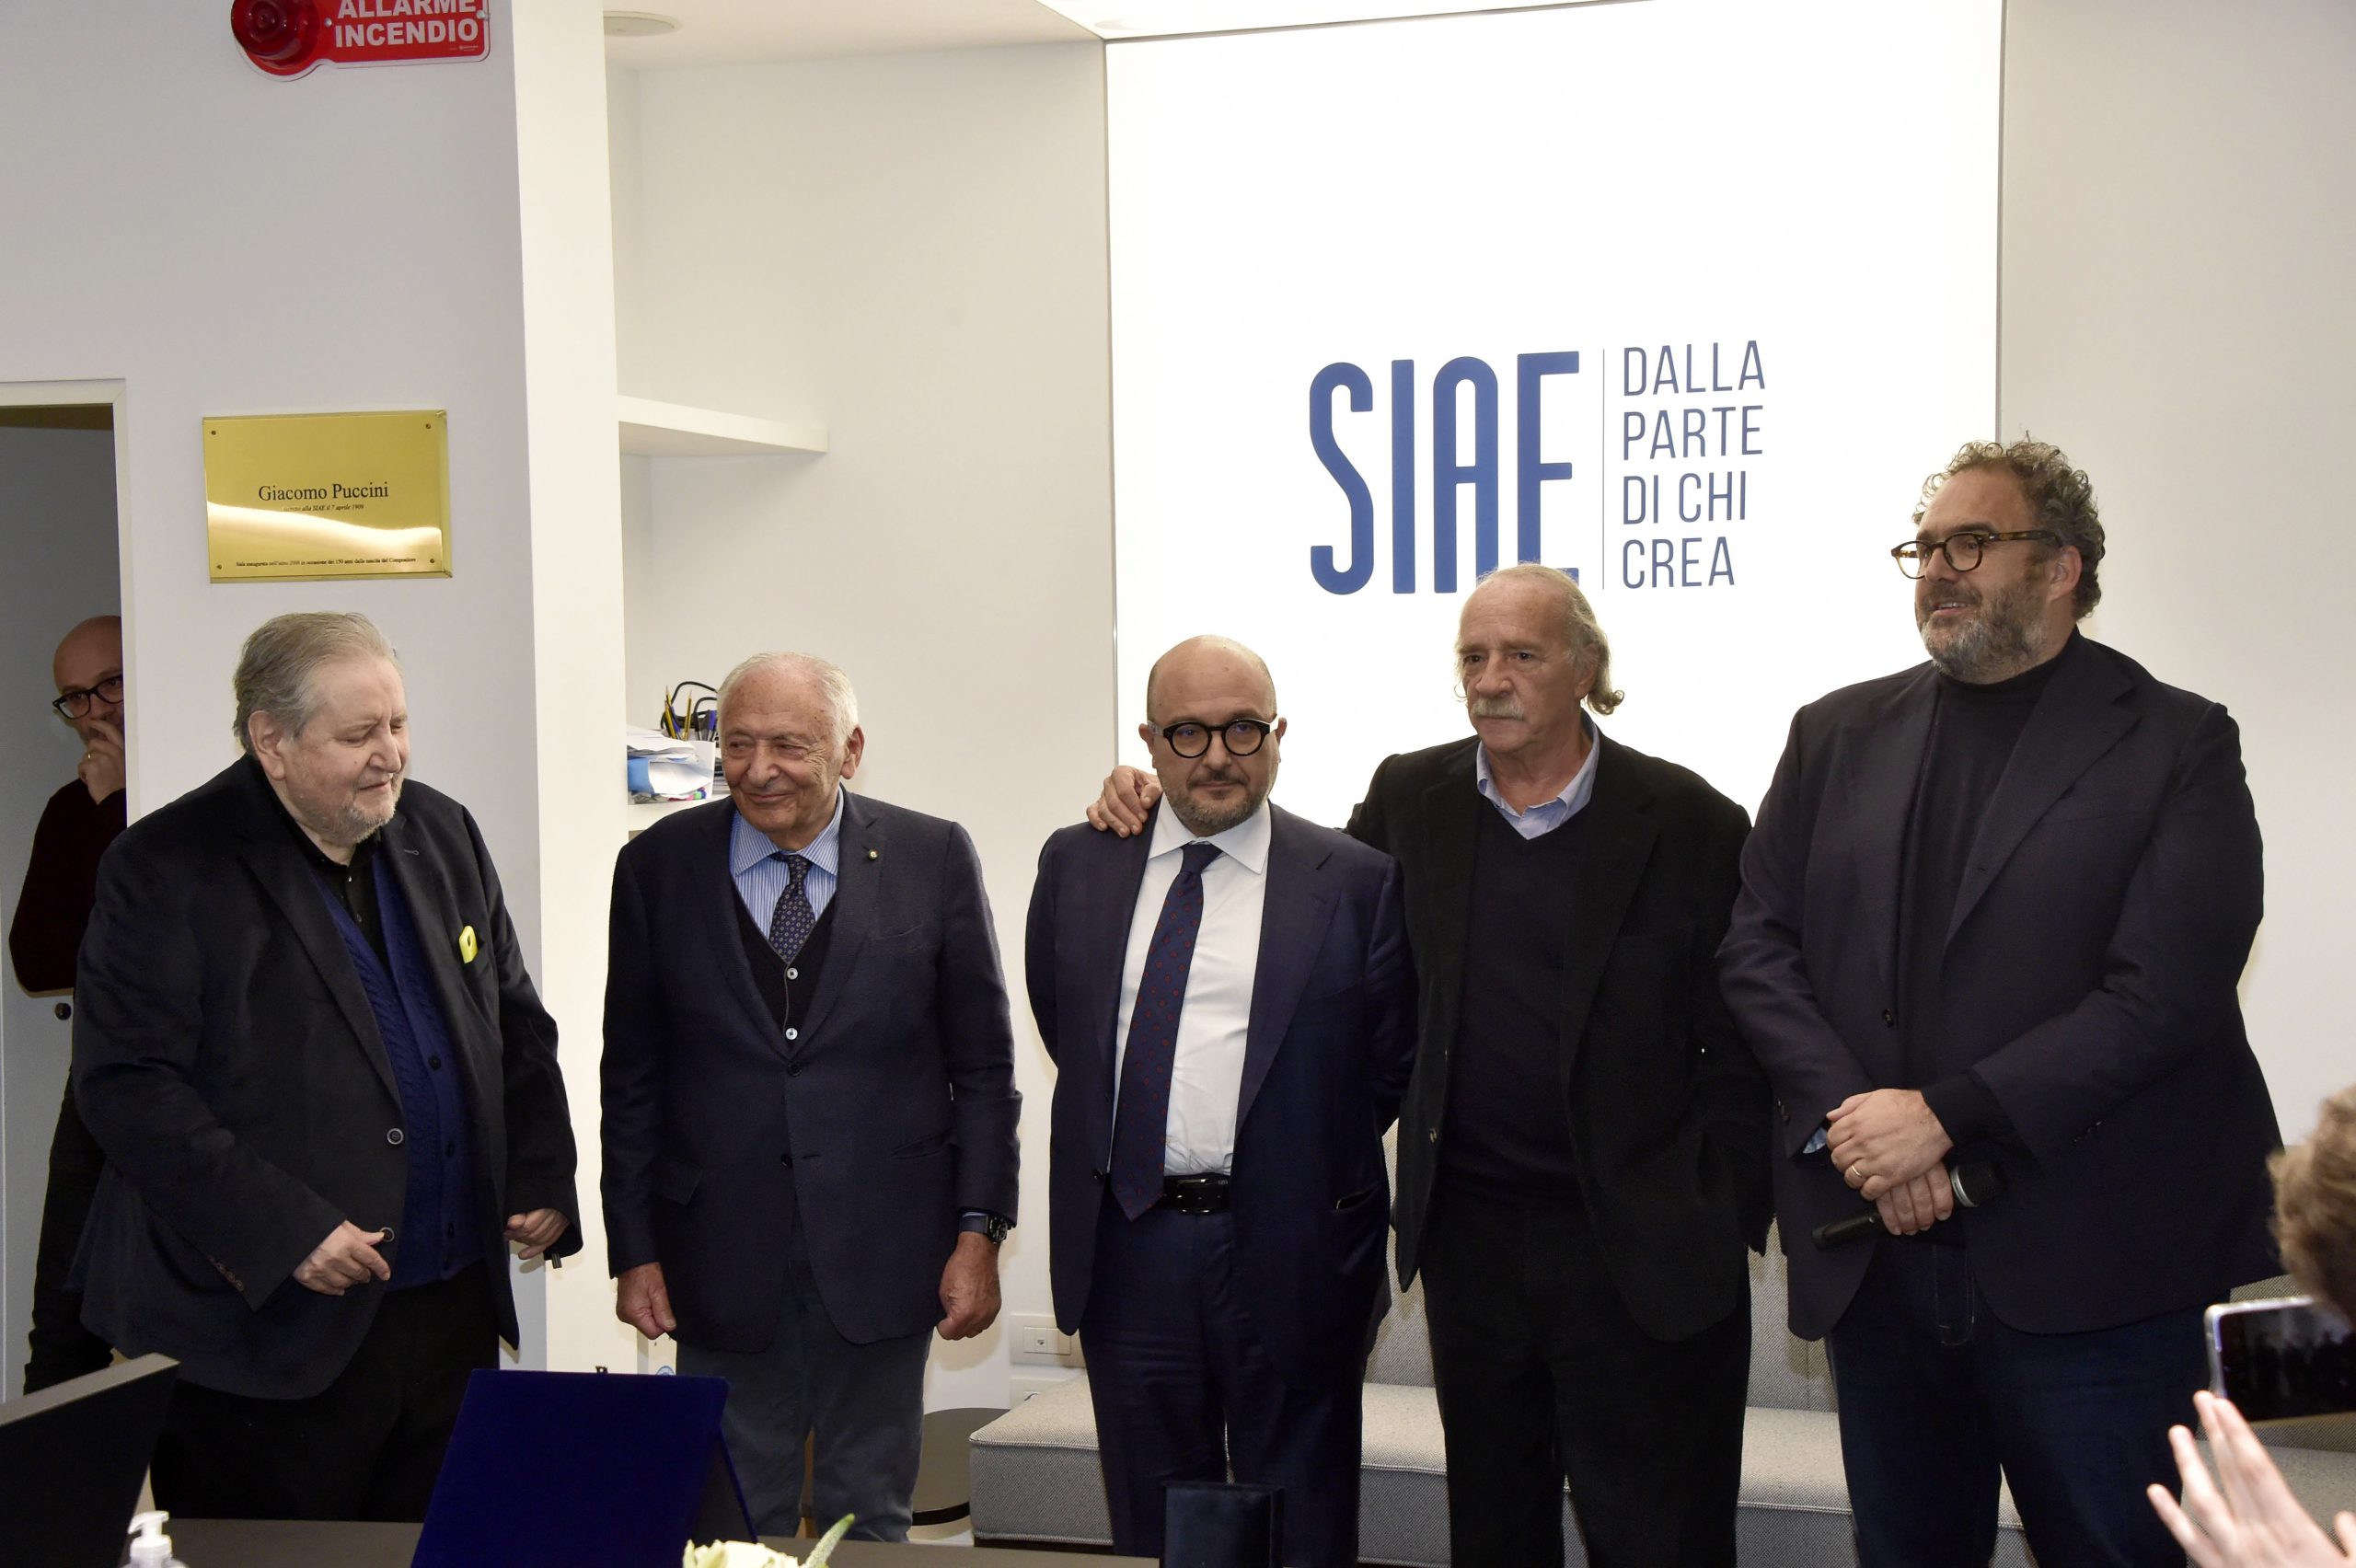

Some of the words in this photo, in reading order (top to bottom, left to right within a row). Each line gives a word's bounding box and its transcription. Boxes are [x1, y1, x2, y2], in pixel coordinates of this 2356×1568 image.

[335, 18, 479, 47] INCENDIO
[337, 0, 476, 18] ALLARME
[1623, 340, 1765, 396] DALLA
[1623, 405, 1763, 460] PARTE
[258, 484, 328, 502] Giacomo
[331, 481, 389, 499] Puccini
[1310, 351, 1579, 595] SIAE
[1623, 474, 1658, 525] DI
[1679, 470, 1747, 523] CHI
[1623, 536, 1735, 590] CREA
